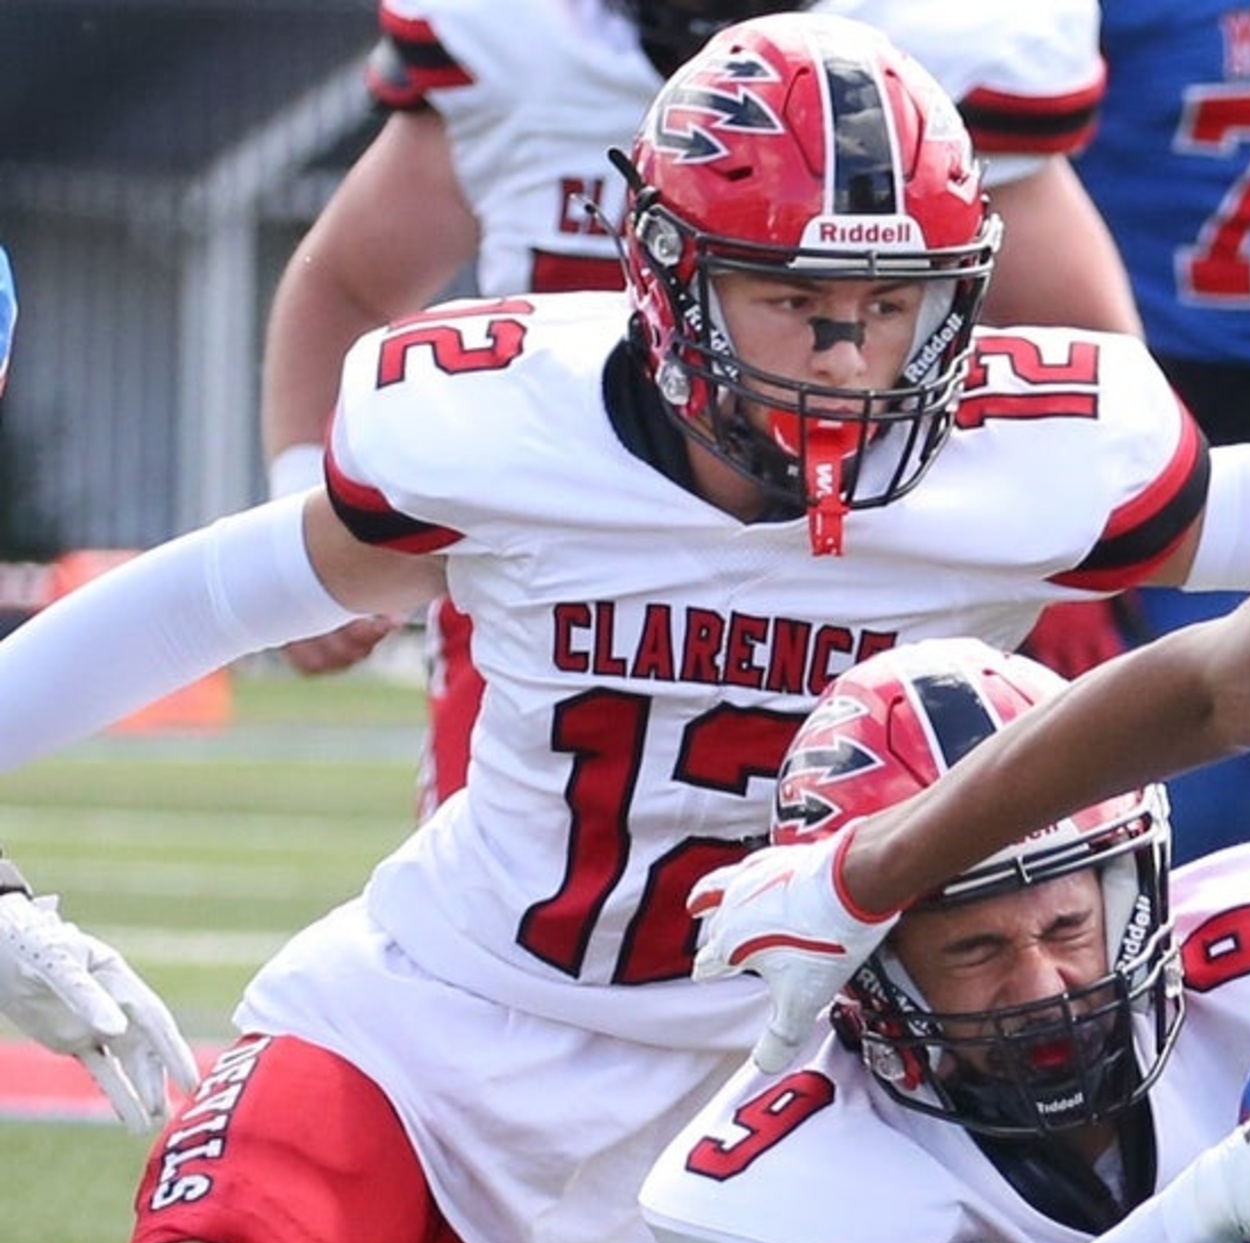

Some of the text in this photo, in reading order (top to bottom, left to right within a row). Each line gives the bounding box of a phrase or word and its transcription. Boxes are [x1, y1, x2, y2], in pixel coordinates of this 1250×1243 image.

[819, 223, 911, 243] Riddell
[904, 311, 964, 383] Riddell
[955, 335, 1099, 430] 12
[684, 1069, 837, 1183] 9
